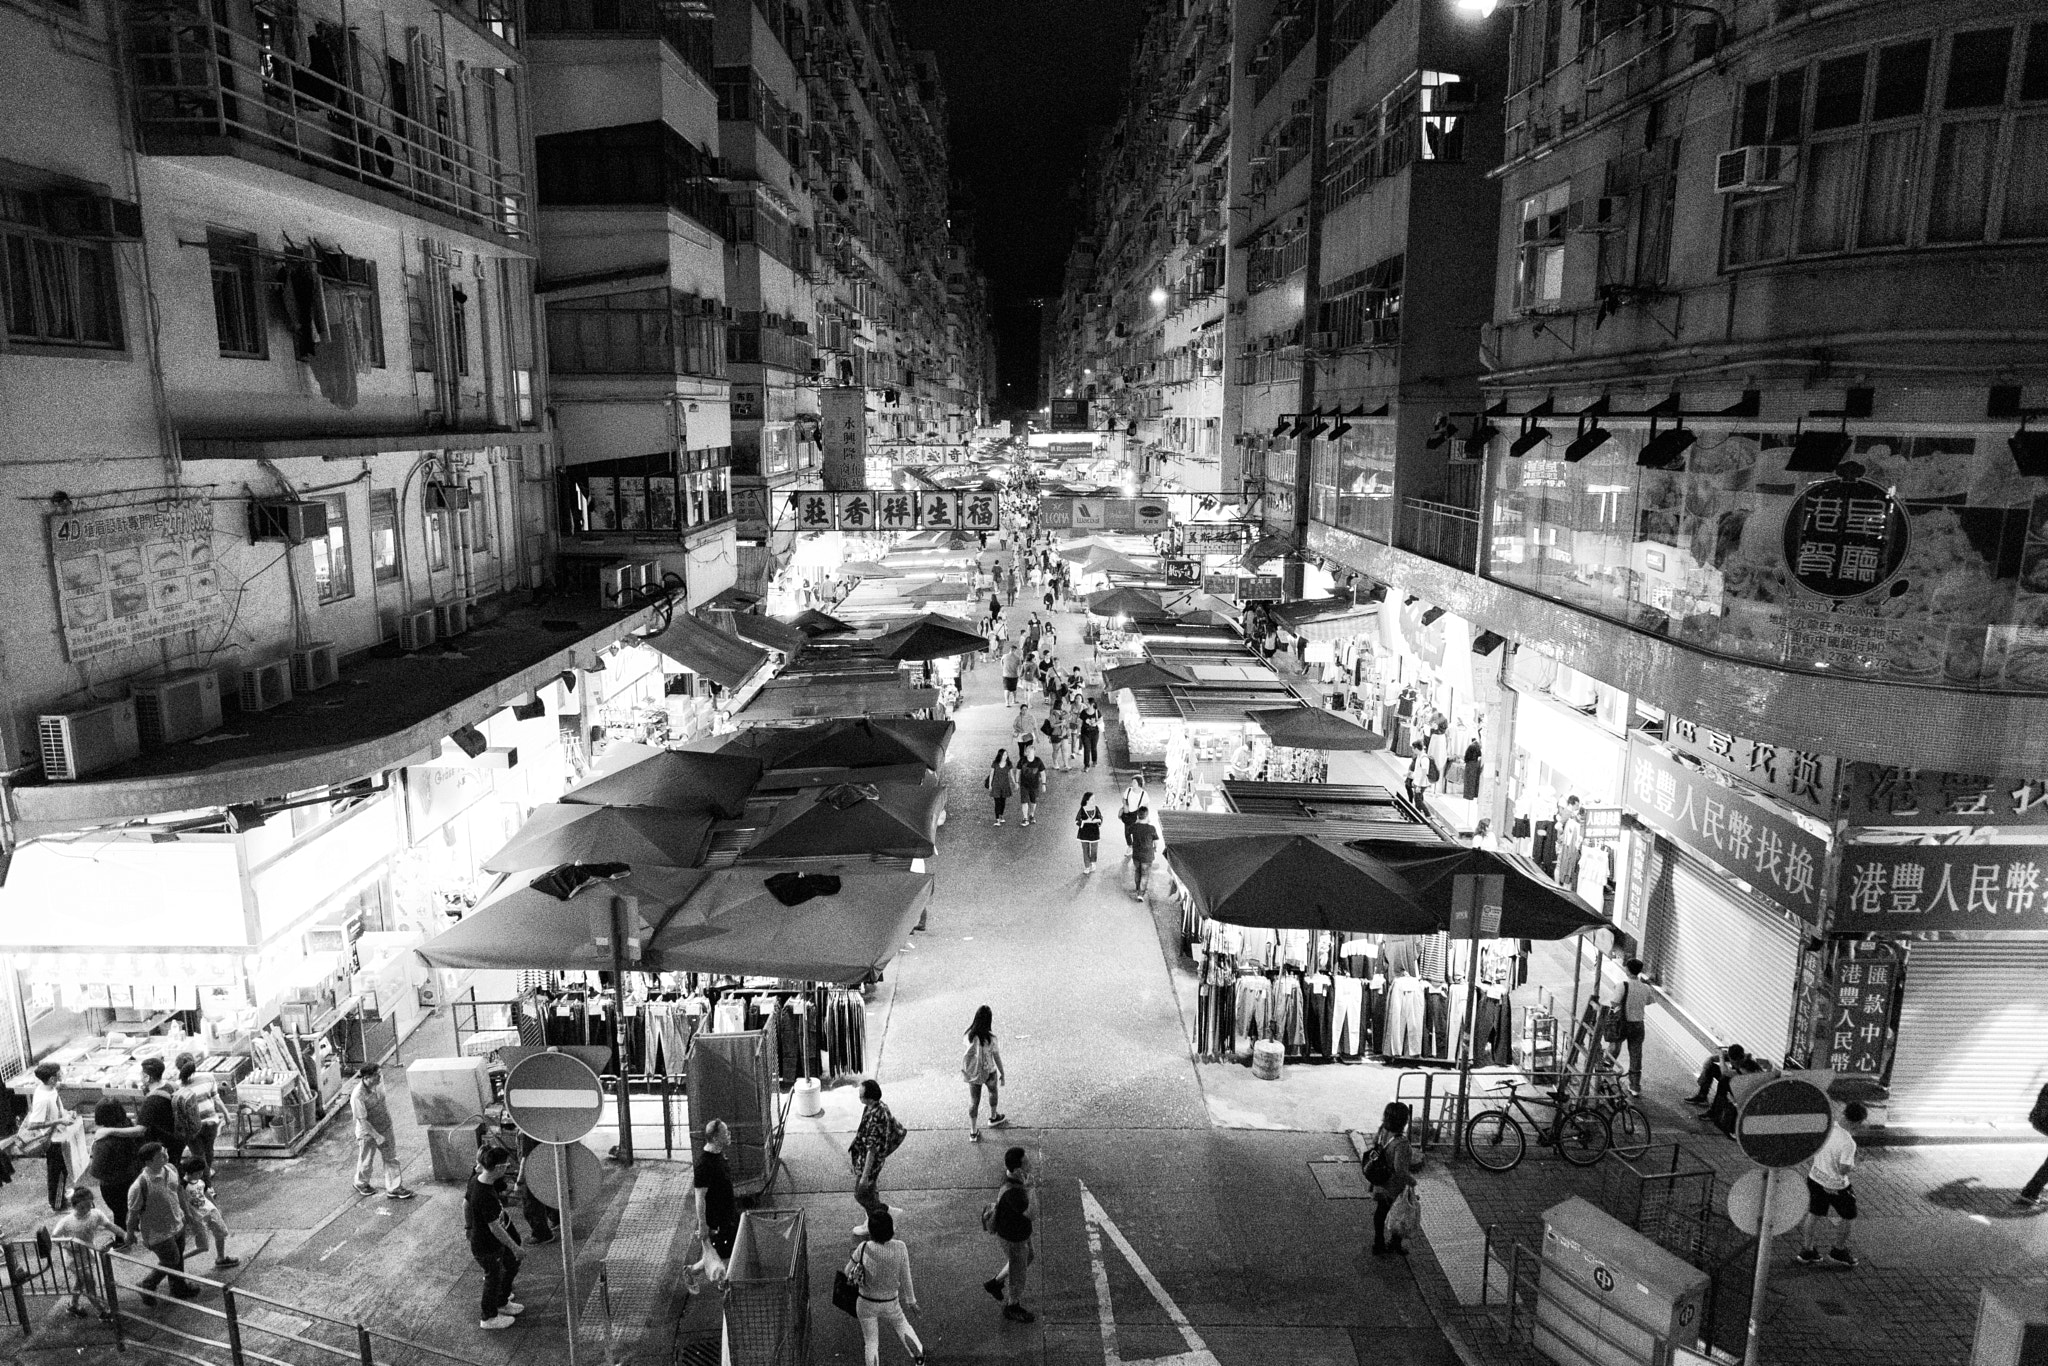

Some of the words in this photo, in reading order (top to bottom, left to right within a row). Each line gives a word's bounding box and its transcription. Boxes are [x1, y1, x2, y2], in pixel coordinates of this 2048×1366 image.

[58, 519, 81, 541] 4D
[1850, 862, 2048, 914] 港豐人民幣
[1830, 964, 1863, 1072] 港豐人民幣
[1855, 965, 1889, 1072] 匯款中心
